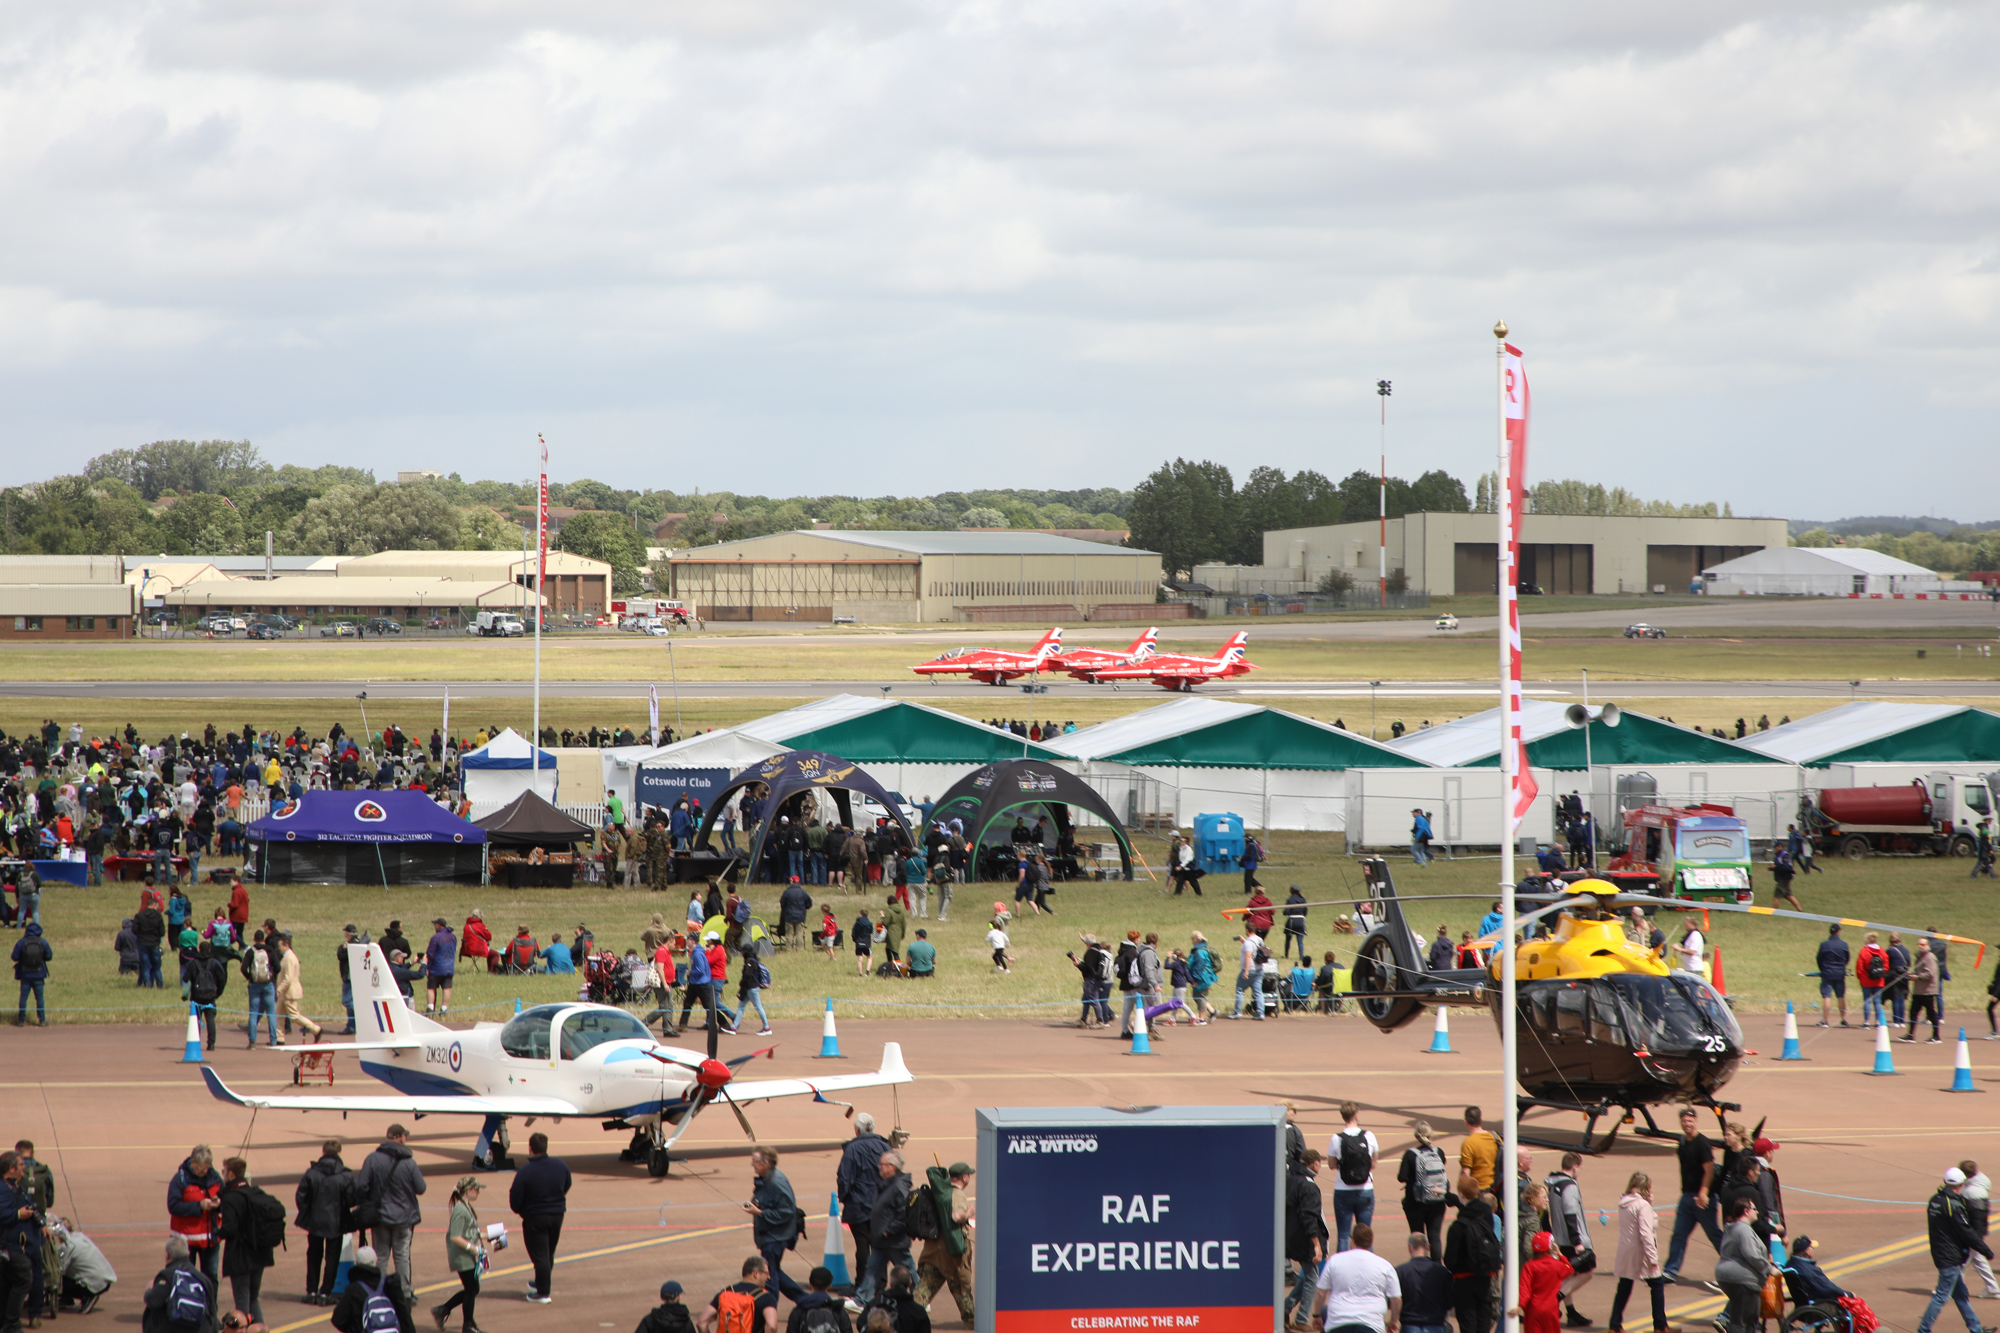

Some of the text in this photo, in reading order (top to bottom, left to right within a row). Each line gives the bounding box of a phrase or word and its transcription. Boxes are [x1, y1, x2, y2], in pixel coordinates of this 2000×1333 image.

[797, 758, 819, 771] 349
[802, 769, 821, 779] SQN
[643, 776, 711, 788] Cotswold Club
[317, 833, 432, 842] 312 TACTICAL FIGHTER SQUADRON
[1695, 875, 1738, 886] CHILD
[1370, 882, 1386, 923] 25
[363, 959, 371, 970] 21
[1703, 1035, 1726, 1053] 25
[426, 1046, 448, 1064] ZM321
[1007, 1139, 1098, 1153] AIR TATTOO
[1102, 1194, 1171, 1224] RAF
[1031, 1241, 1240, 1273] EXPERIENCE
[1070, 1315, 1200, 1329] CELEBRATING THE RAF
